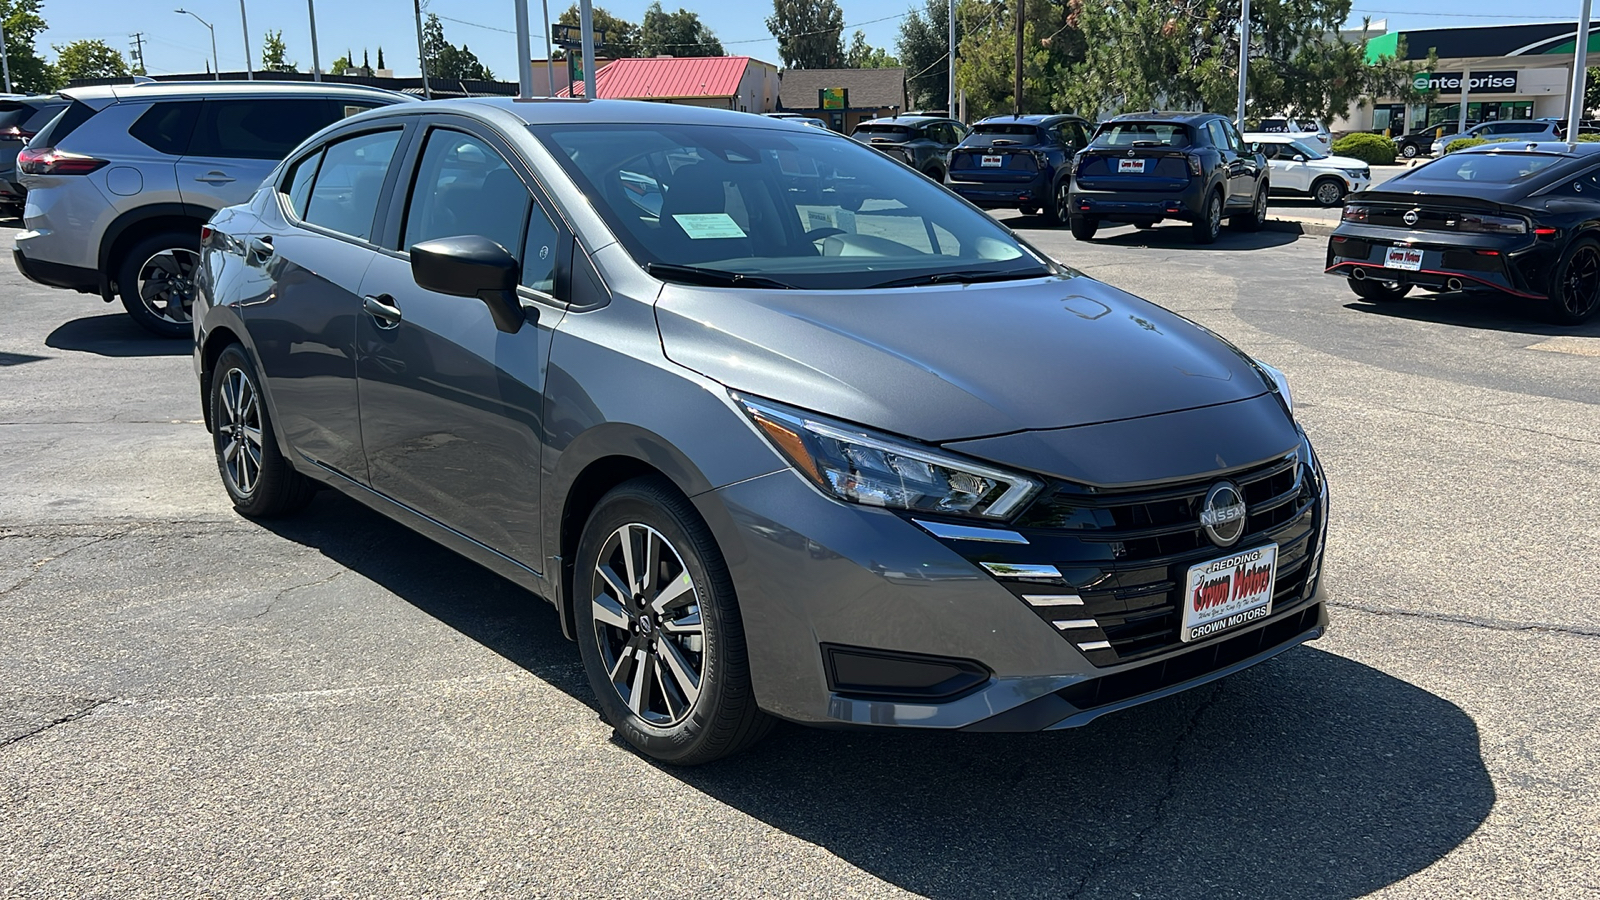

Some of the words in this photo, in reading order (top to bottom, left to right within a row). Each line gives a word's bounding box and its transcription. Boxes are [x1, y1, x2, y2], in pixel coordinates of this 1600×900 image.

[1201, 503, 1246, 524] NISSAN
[1212, 552, 1258, 571] REDDING
[1193, 575, 1230, 612] Crown
[1232, 563, 1271, 601] Motors
[1191, 619, 1226, 638] CROWN
[1228, 606, 1267, 626] MOTORS
